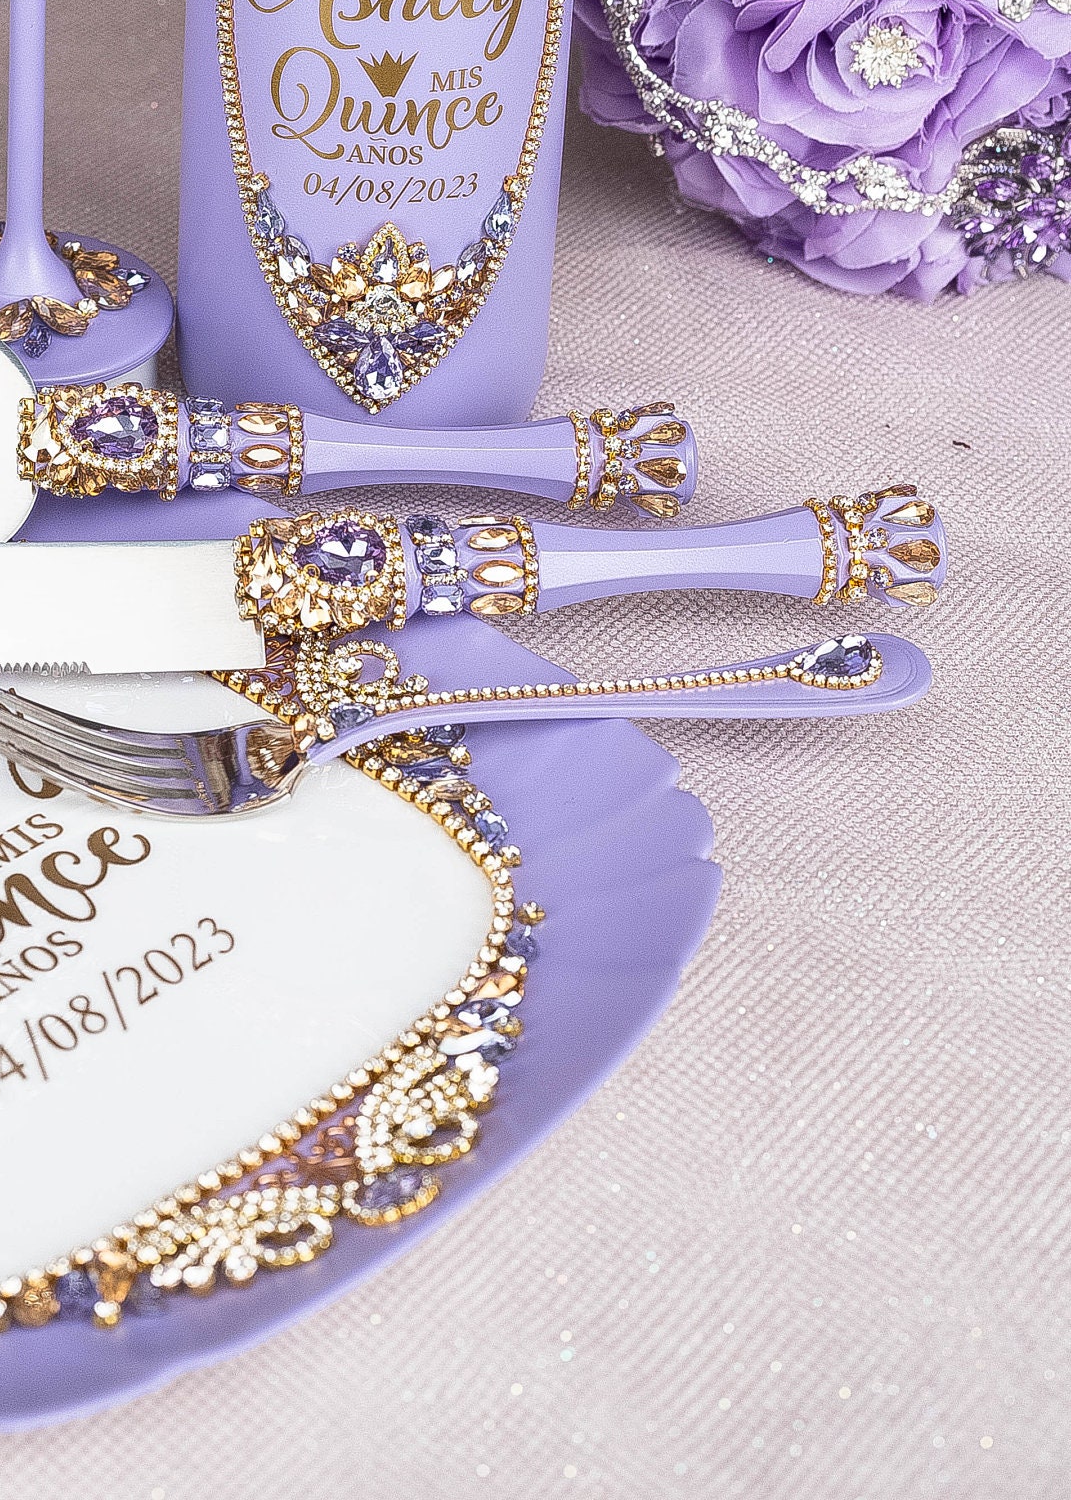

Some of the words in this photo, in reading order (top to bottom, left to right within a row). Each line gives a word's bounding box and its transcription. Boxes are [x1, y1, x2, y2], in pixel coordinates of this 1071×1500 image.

[430, 66, 483, 92] MIS
[270, 46, 503, 160] Quince
[346, 137, 424, 165] AÑOS
[303, 172, 479, 206] 04/08/2023
